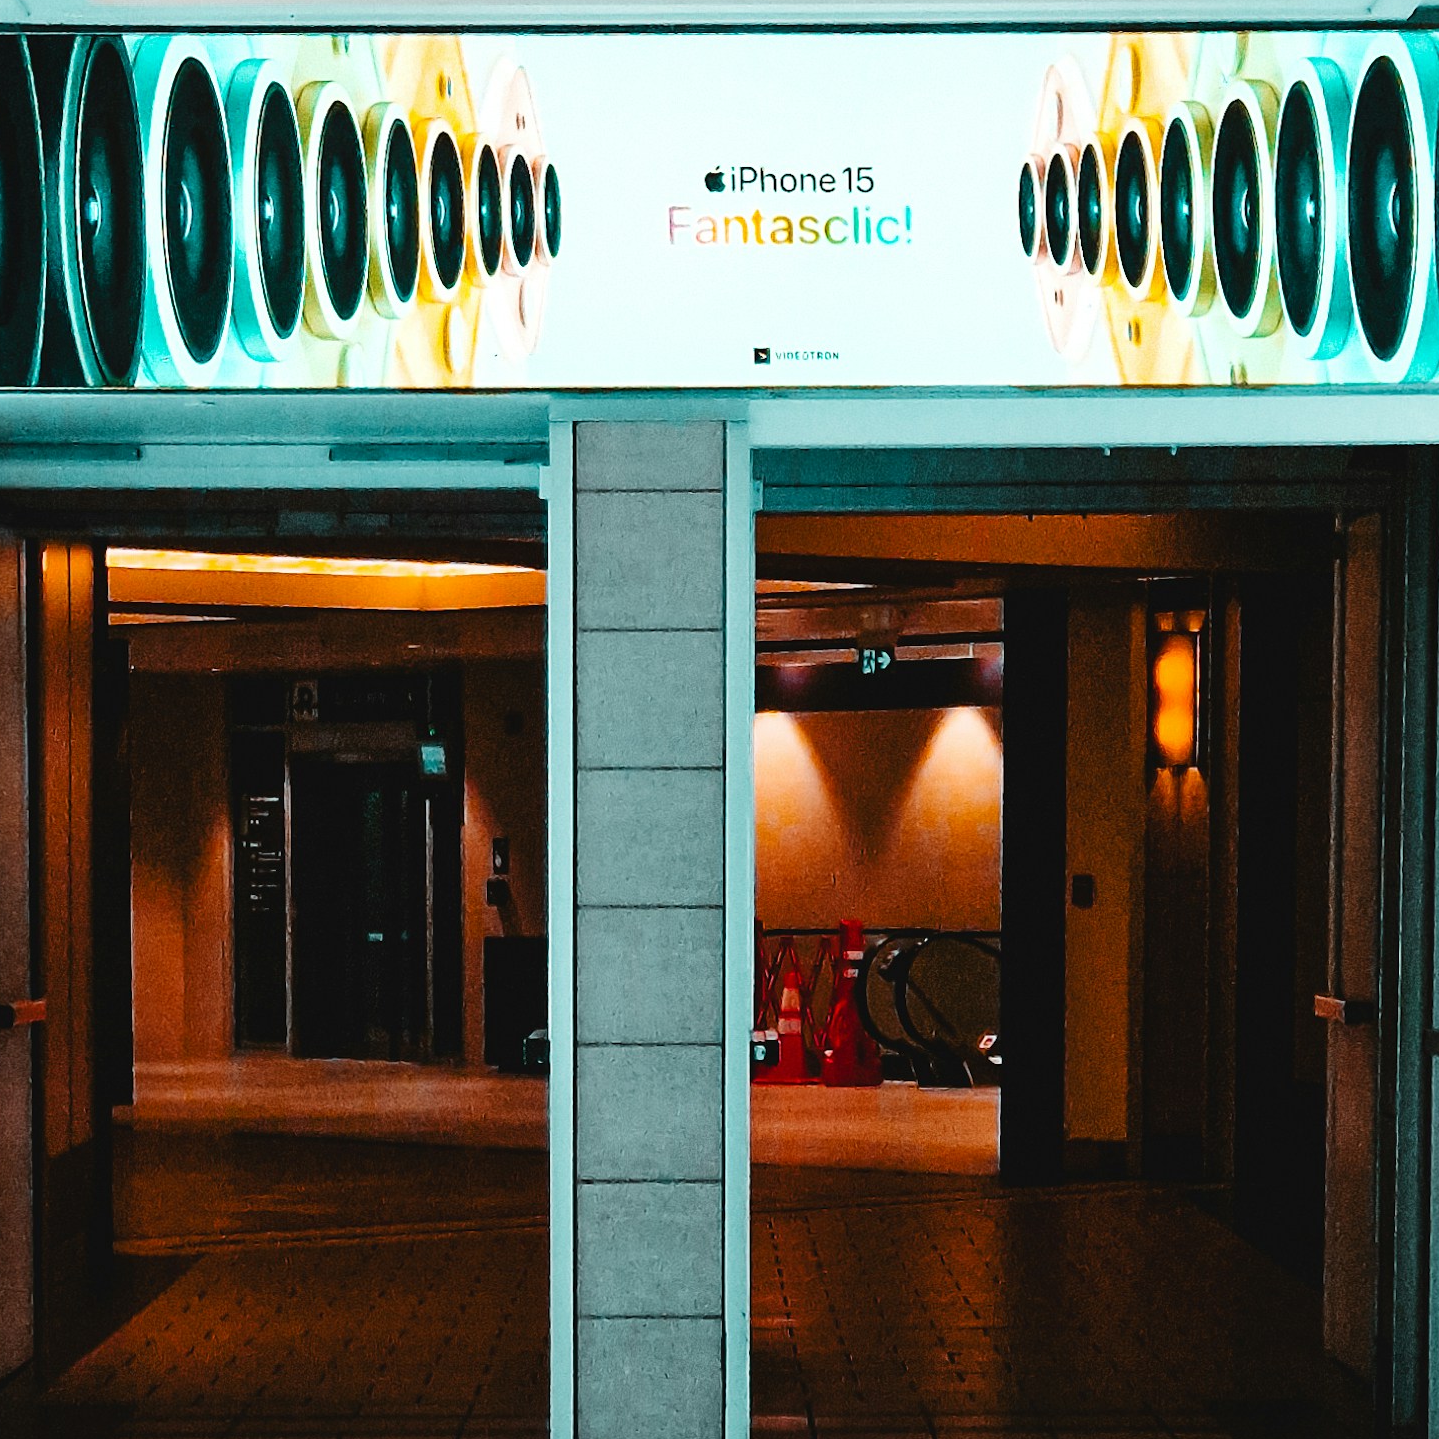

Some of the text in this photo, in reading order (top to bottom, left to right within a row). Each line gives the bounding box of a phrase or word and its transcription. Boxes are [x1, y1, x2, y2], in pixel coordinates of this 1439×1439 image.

[731, 166, 875, 193] iPhone 15
[668, 205, 913, 245] Fantasclic!
